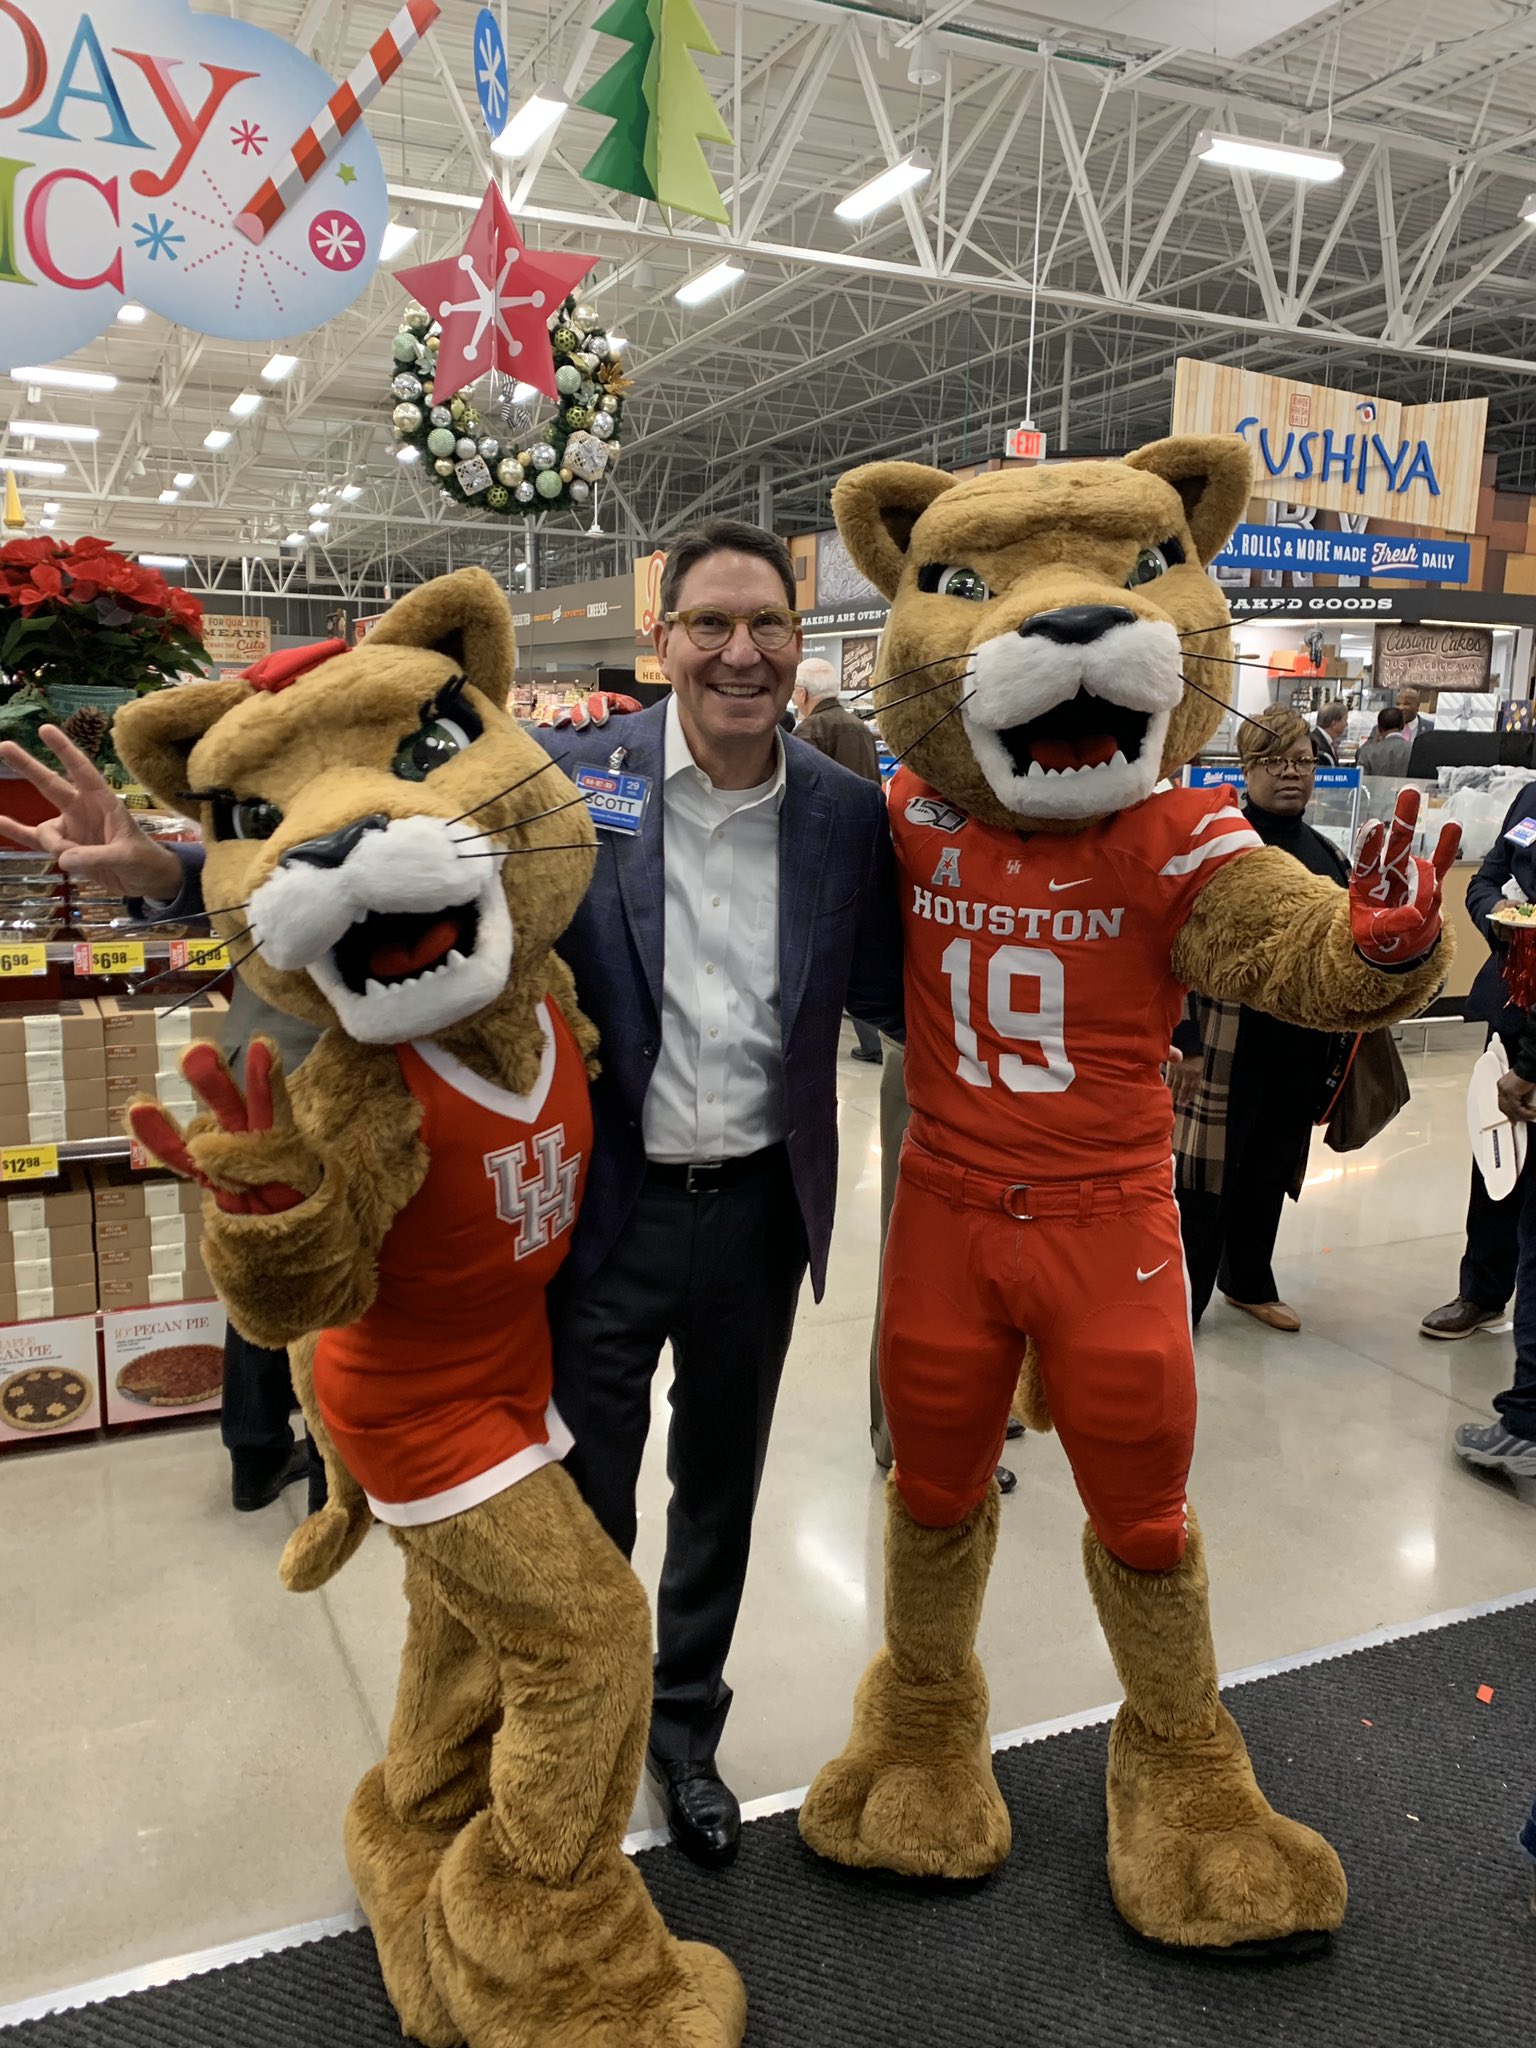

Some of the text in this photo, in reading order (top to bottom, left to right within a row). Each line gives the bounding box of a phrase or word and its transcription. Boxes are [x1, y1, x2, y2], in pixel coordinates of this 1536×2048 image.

[1016, 430, 1041, 457] EXIT
[1241, 533, 1281, 558] ROLLS
[1284, 540, 1294, 557] &
[1296, 538, 1331, 562] MORE
[1333, 545, 1367, 563] MADE
[1371, 541, 1419, 569] Fresh
[1422, 553, 1455, 570] DAILY
[586, 602, 608, 618] CHEESES
[1308, 598, 1393, 610] GOODS
[209, 618, 259, 627] FOR QUALITY
[801, 614, 835, 626] BAKERS
[836, 612, 856, 623] ARE
[204, 628, 266, 638] MEATS
[1386, 628, 1483, 653] Custom Cakes
[626, 780, 640, 791] 29
[584, 791, 636, 814] SCOTT
[912, 884, 1126, 943] HOUSTON
[940, 937, 1076, 1093] 19
[133, 1320, 183, 1337] PECAN
[186, 1316, 210, 1330] PIE
[28, 1344, 52, 1358] PIE
